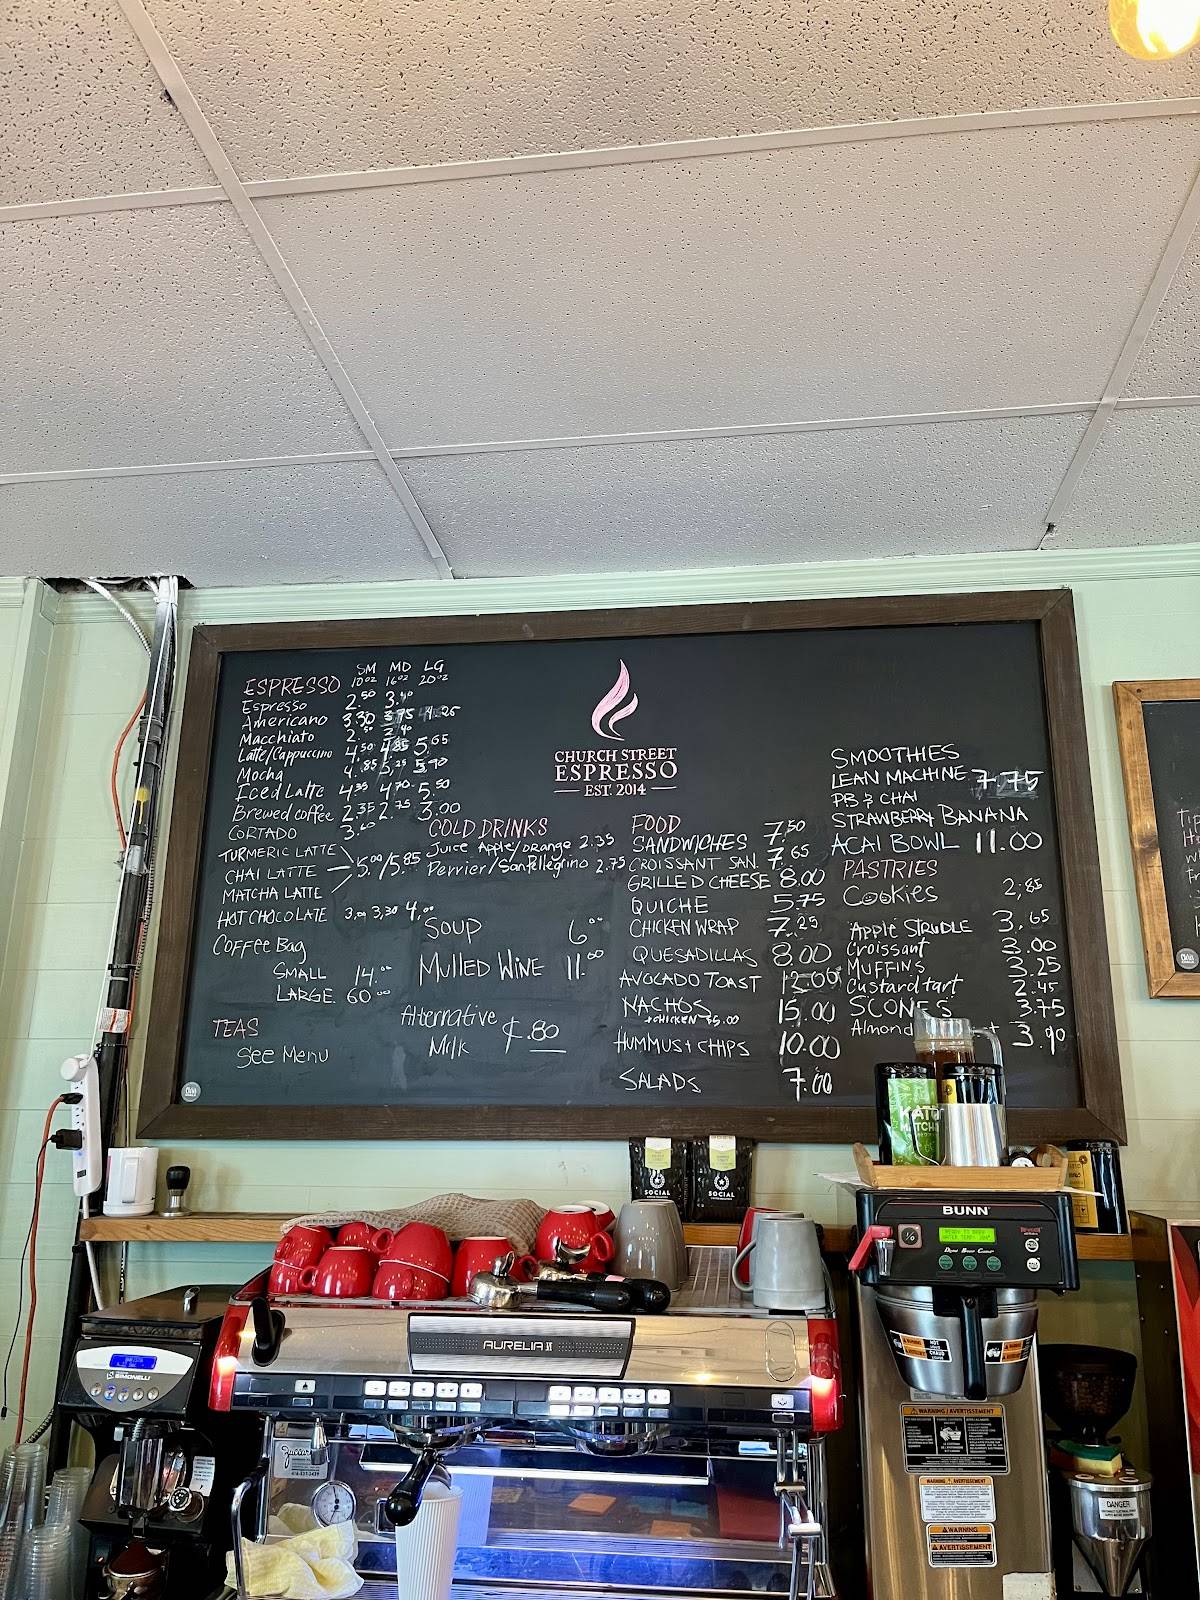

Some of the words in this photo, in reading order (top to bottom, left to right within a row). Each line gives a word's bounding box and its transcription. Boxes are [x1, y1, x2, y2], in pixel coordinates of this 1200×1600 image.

[356, 662, 377, 675] SM
[389, 661, 411, 673] MD
[424, 660, 444, 673] LG
[243, 675, 341, 696] ESPRESSO
[242, 699, 308, 717] Espresso
[241, 715, 328, 732] Americano
[239, 729, 315, 746] Macchiato
[237, 748, 333, 767] Latte/Cappuccino
[554, 749, 618, 763] CHURCH
[621, 748, 677, 760] STREET
[831, 744, 960, 769] SMOOTHIES
[236, 767, 284, 783] Mocha
[554, 761, 678, 782] ESPRESSO
[831, 770, 879, 789] LEAN
[887, 765, 968, 785] MACHINE
[235, 783, 280, 802] Iced
[284, 780, 325, 800] Latte
[584, 784, 612, 797] EST.
[616, 783, 647, 796] 2014
[879, 790, 917, 805] CHAI
[232, 803, 290, 822] Brewed
[294, 804, 334, 823] coffee
[418, 801, 461, 821] 3.00
[831, 809, 935, 830] STRAWBERRY
[938, 804, 1029, 826] BANANA
[428, 818, 476, 838] COLD
[478, 817, 548, 838] DRINKS
[632, 814, 681, 834] FOOD
[426, 841, 468, 858] Juice
[579, 833, 615, 849] 2.35
[632, 834, 748, 855] SANDWICHES
[831, 832, 881, 856] ACAI
[890, 831, 960, 853] BOWL
[976, 828, 1043, 854] 11.00
[218, 846, 289, 863] TURMERIC
[296, 844, 337, 858] LATTE
[225, 868, 260, 885] CHAI
[267, 865, 317, 880] LATTE
[628, 857, 721, 872] CROISSANT
[843, 859, 938, 880] PASTRIES
[627, 875, 704, 892] GRILLED
[709, 873, 771, 890] CHEESE
[780, 867, 826, 889] 8.00
[223, 887, 278, 904] MATCHA
[284, 886, 322, 900] LATTE
[631, 896, 709, 915] QUICHE
[770, 893, 826, 913] 5.75
[217, 909, 248, 929] HOT
[249, 907, 328, 925] CHOCOLATE
[629, 919, 692, 938] CHICKEN
[695, 918, 739, 937] WRAP
[904, 918, 973, 938] STRUDLE
[992, 909, 1050, 933] 3.65
[276, 938, 307, 964] Bag
[632, 946, 758, 968] QUESADILLAS
[772, 942, 832, 967] 8.00
[847, 937, 930, 958] Croissant
[1001, 937, 1057, 954] 3.00
[273, 962, 327, 982] SMALL
[847, 958, 926, 977] MUFFINS
[1006, 957, 1061, 977] 3.25
[619, 969, 700, 989] AVOCADO
[704, 971, 762, 993] TOAST
[847, 975, 919, 994] Custard
[922, 973, 963, 994] tart
[401, 1004, 497, 1028] Alternative
[622, 995, 712, 1018] NACHOS
[779, 998, 836, 1025] 15.00
[1016, 999, 1065, 1019] 3.75
[212, 1018, 259, 1039] TEAS
[851, 1019, 914, 1037] Almond
[429, 1034, 469, 1060] Milk
[697, 1038, 750, 1058] CHIPS
[779, 1030, 841, 1060] 10.00
[236, 1046, 275, 1068] See
[283, 1045, 328, 1064] Menu
[619, 1067, 701, 1093] SALADS
[782, 1066, 833, 1102] 7.00
[708, 1190, 735, 1198] SOCIAL
[942, 1206, 989, 1215] BUNN
[483, 1341, 543, 1351] AURELIA
